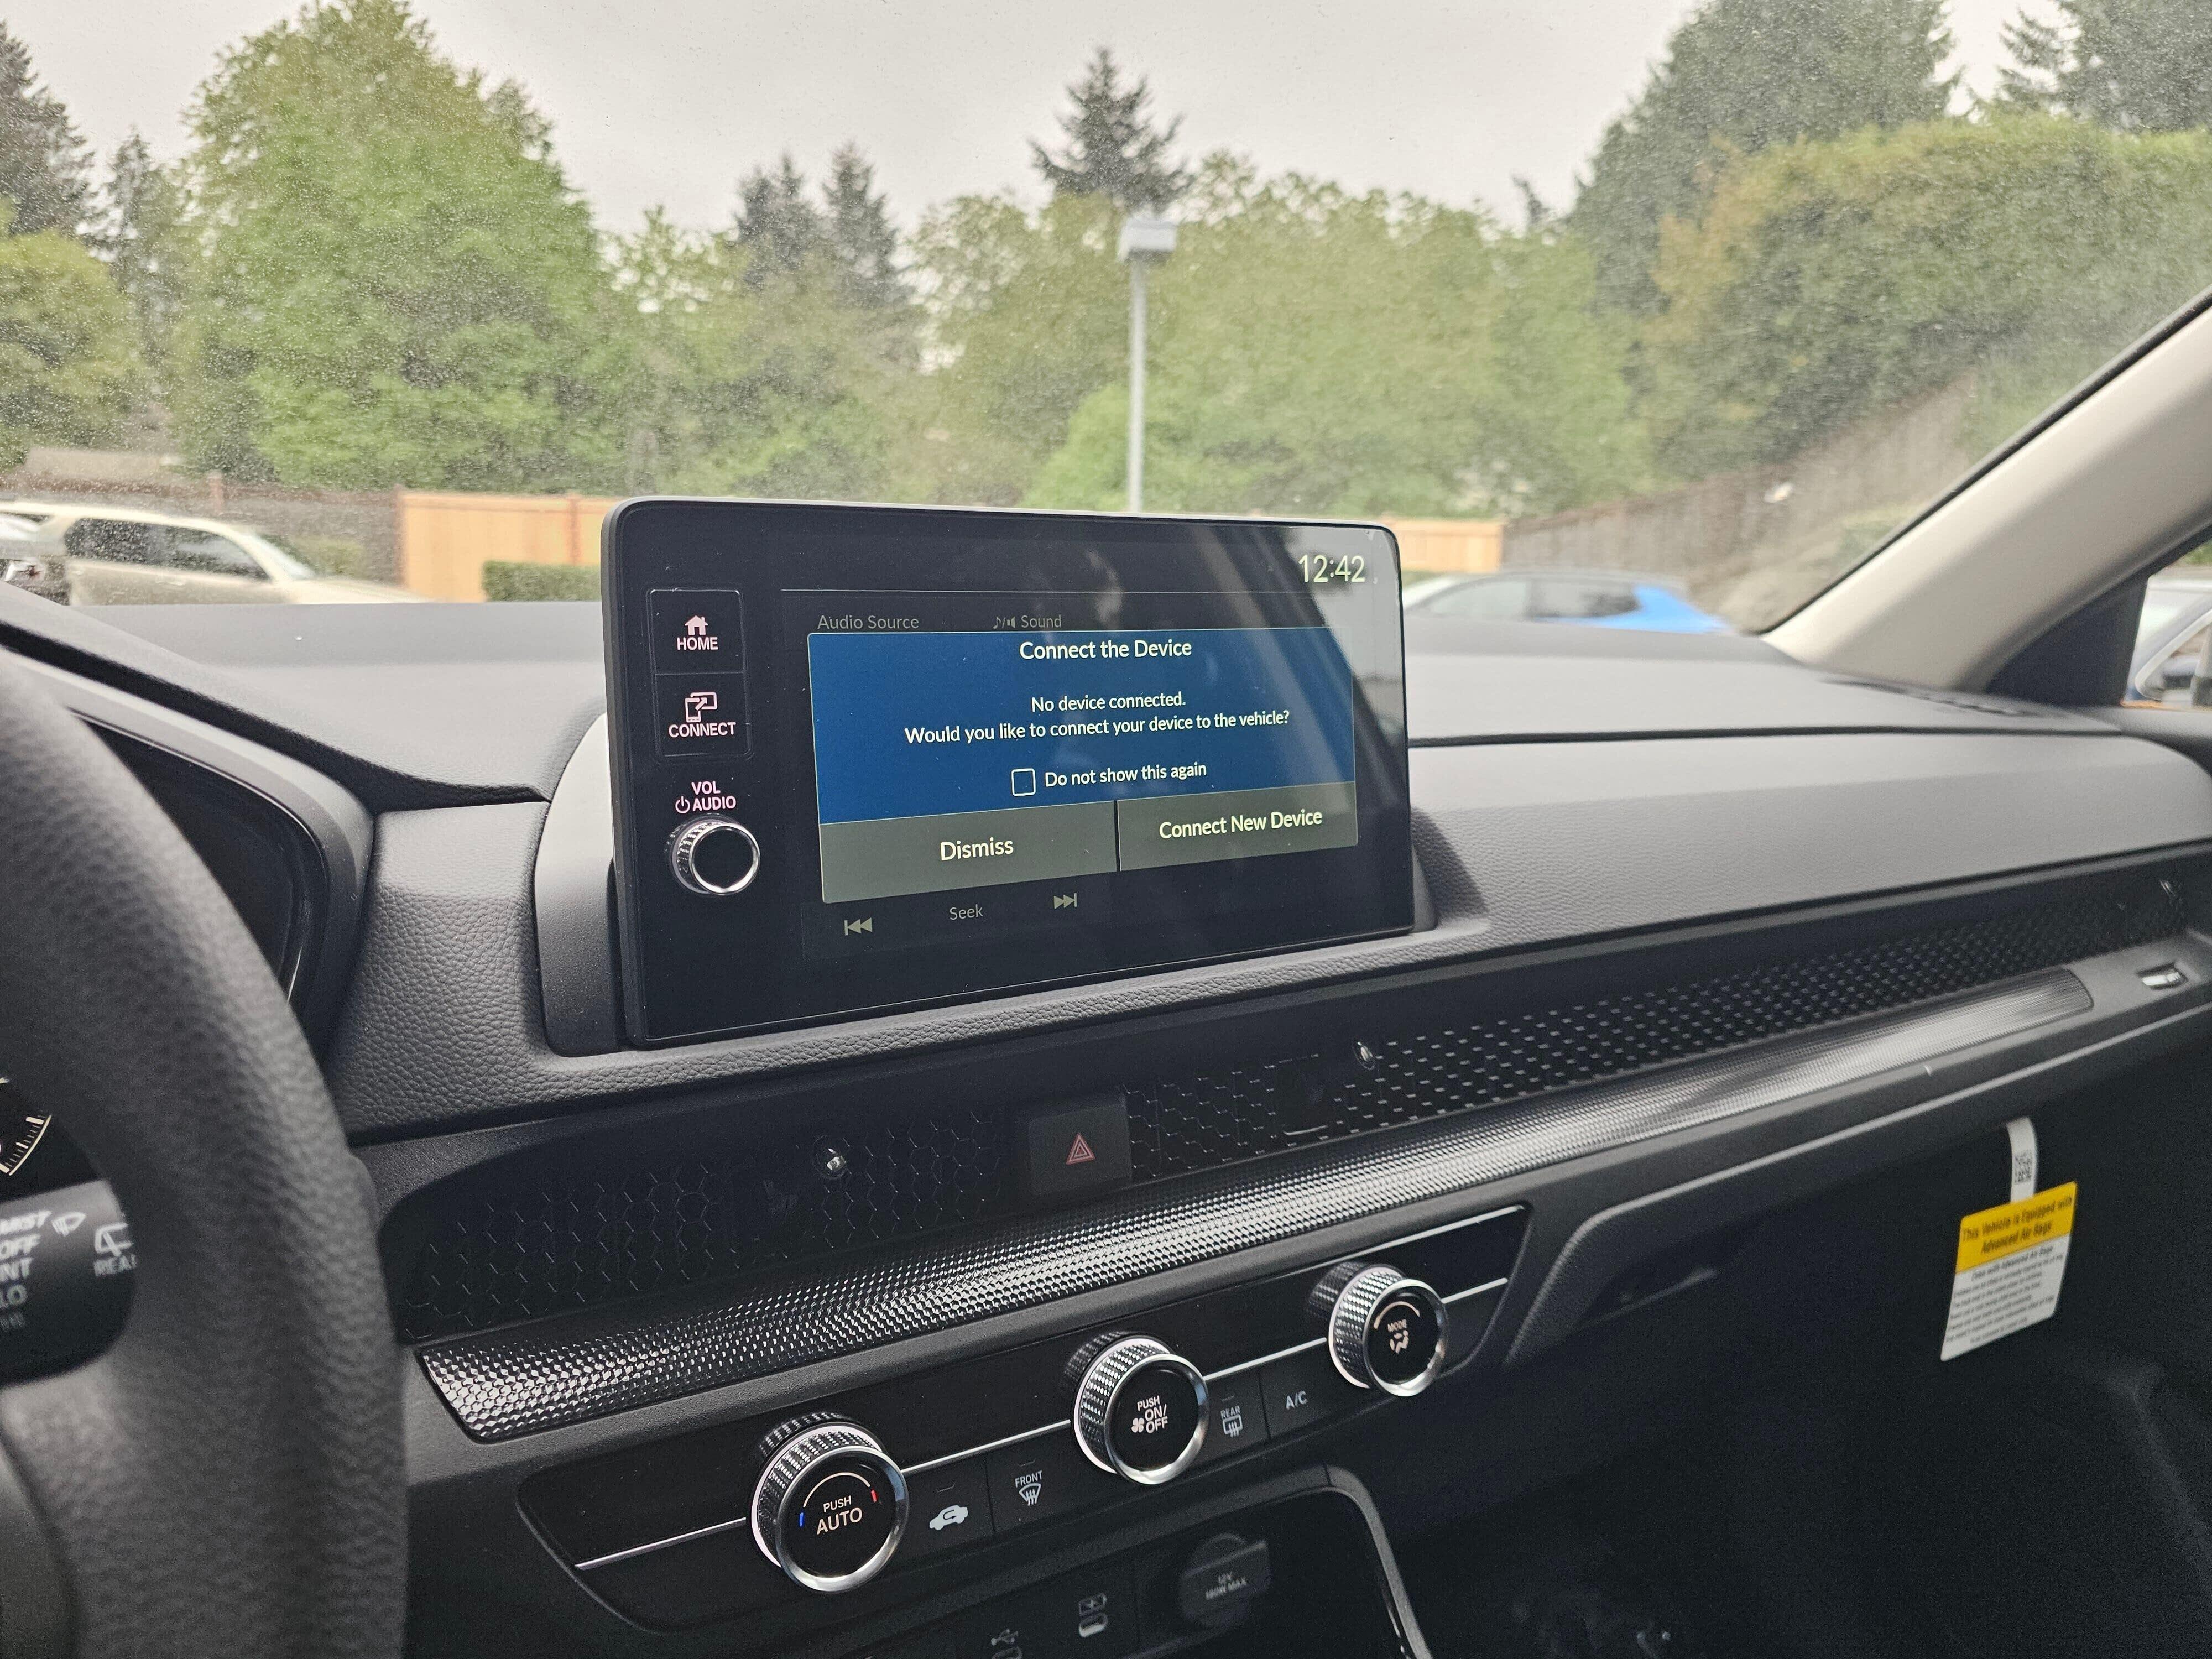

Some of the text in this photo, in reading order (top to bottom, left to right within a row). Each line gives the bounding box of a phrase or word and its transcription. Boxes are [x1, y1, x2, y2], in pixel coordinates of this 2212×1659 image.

[1298, 555, 1366, 583] 12:42
[817, 615, 920, 629] Audio Source
[1021, 614, 1062, 629] Sound
[676, 637, 719, 651] HOME
[1019, 639, 1192, 660] Connect the Device
[1031, 692, 1186, 712] No device connected.
[668, 722, 736, 737] CONNECT
[905, 709, 1289, 744] Would you like to connect your device to the vehicle?
[1045, 762, 1207, 787] Do not show this again
[691, 781, 721, 795] VOL
[693, 795, 737, 811] AUDIO
[1159, 810, 1323, 840] Connect New Device
[940, 838, 1014, 860] Dismiss
[949, 904, 983, 920] Seek
[1981, 1216, 2011, 1236] Vehicle
[2022, 1199, 2056, 1223] Equipped
[0, 1234, 40, 1261] OFF
[1387, 1319, 1407, 1332] MODE
[1137, 1395, 1161, 1410] PUSH
[1285, 1390, 1308, 1410] A/C
[1145, 1404, 1167, 1421] ON/
[1220, 1405, 1241, 1418] REAR
[1146, 1416, 1168, 1434] OFF
[1015, 1470, 1043, 1487] FRONT
[823, 1495, 852, 1513] PUSH
[816, 1507, 863, 1535] AUTO
